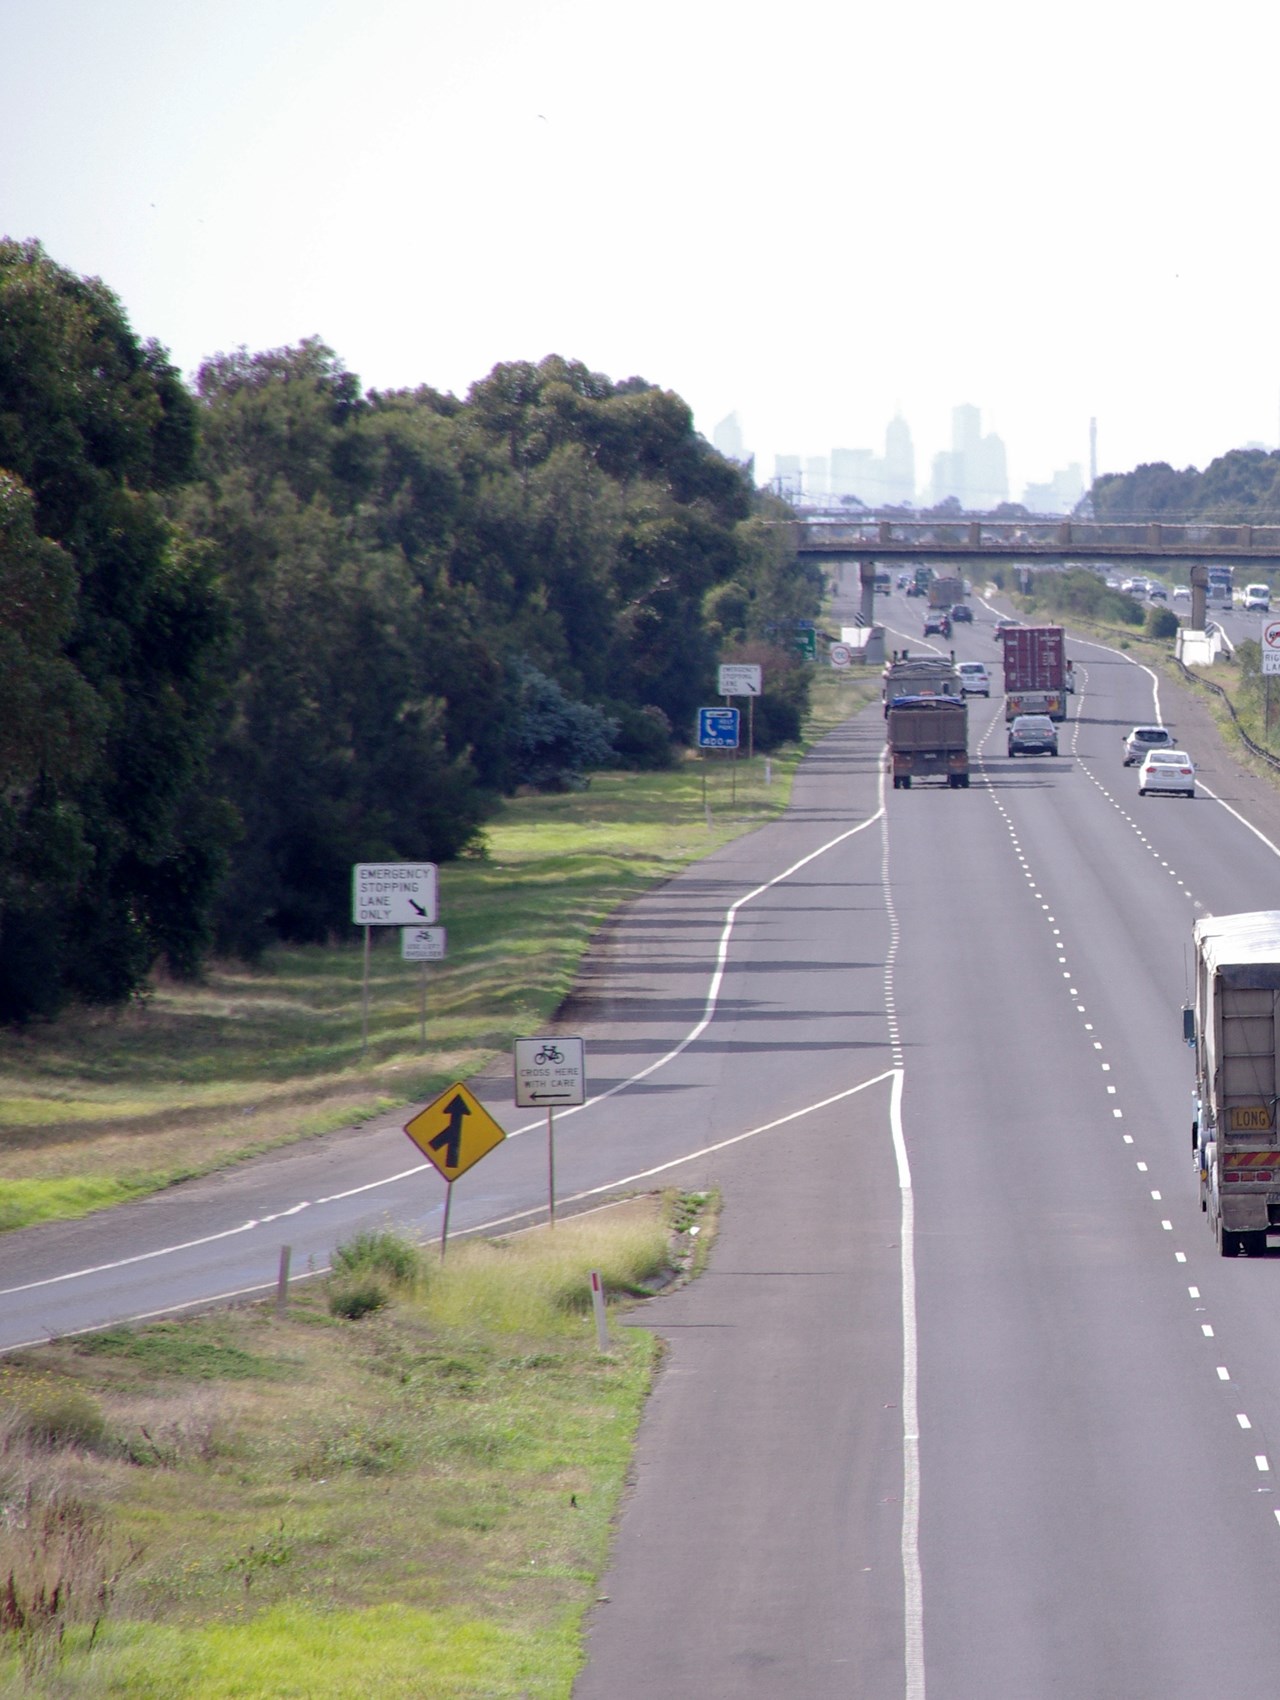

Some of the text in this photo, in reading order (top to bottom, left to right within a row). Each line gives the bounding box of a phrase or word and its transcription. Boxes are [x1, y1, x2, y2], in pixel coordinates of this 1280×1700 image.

[360, 869, 430, 880] EMERGENCY
[360, 882, 419, 893] STOPPING
[360, 896, 391, 906] LANE
[360, 910, 392, 920] ONLY
[1236, 1111, 1266, 1126] LONG
